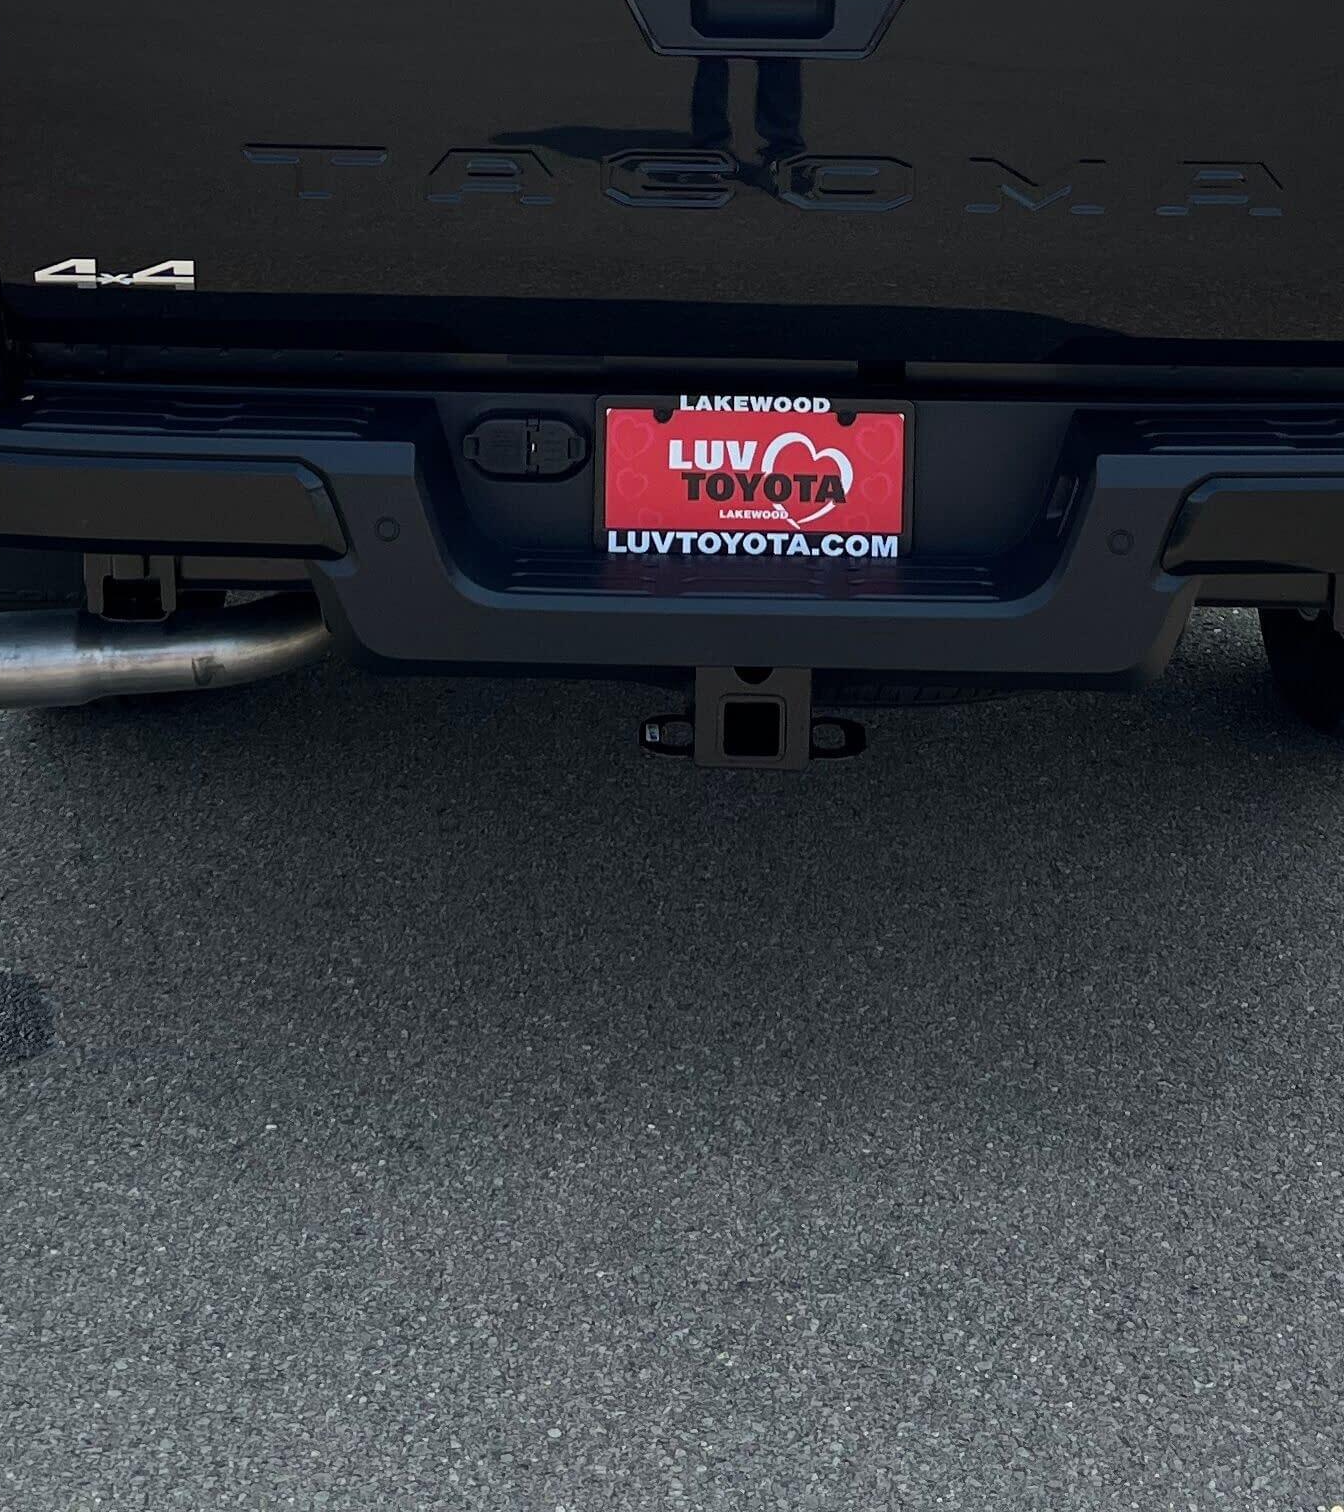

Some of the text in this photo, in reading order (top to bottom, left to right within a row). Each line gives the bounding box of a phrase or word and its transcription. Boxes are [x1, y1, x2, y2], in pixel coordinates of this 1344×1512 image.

[242, 143, 1283, 218] TACOMA
[34, 257, 195, 291] 4x4
[679, 395, 831, 413] LAKEWOOD
[668, 439, 758, 471] LUV
[681, 472, 846, 504] TOYOTA
[719, 509, 789, 520] LAKEWOOD
[607, 530, 898, 558] LUVTOYOTA.COM
